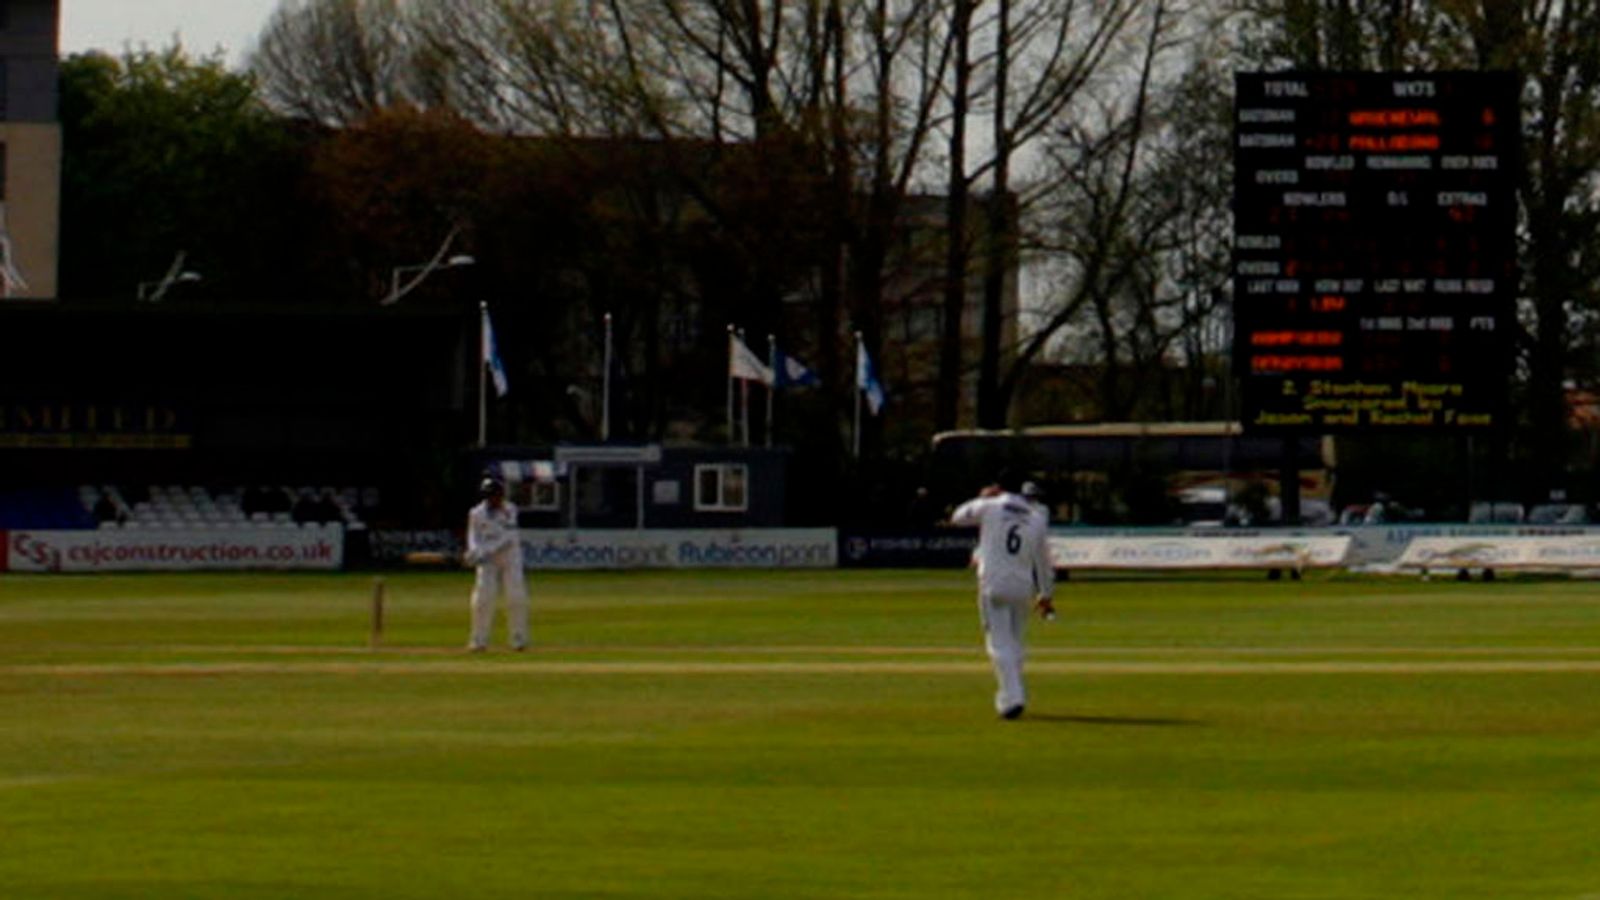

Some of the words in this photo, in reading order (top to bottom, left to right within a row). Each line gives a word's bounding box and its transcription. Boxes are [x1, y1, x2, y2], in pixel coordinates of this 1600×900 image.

[1263, 81, 1309, 97] TOTAL
[1393, 81, 1436, 96] WKTS
[1255, 170, 1299, 184] OVERS
[1437, 192, 1488, 206] EXTRAS
[1247, 280, 1273, 294] LAST
[1374, 280, 1401, 293] LAST
[1401, 381, 1464, 396] Moore
[1254, 410, 1313, 425] Jason
[1323, 409, 1359, 425] and
[1369, 409, 1434, 425] Rachel
[1006, 524, 1021, 555] 6
[68, 541, 333, 565] csjconstruction.co.uk
